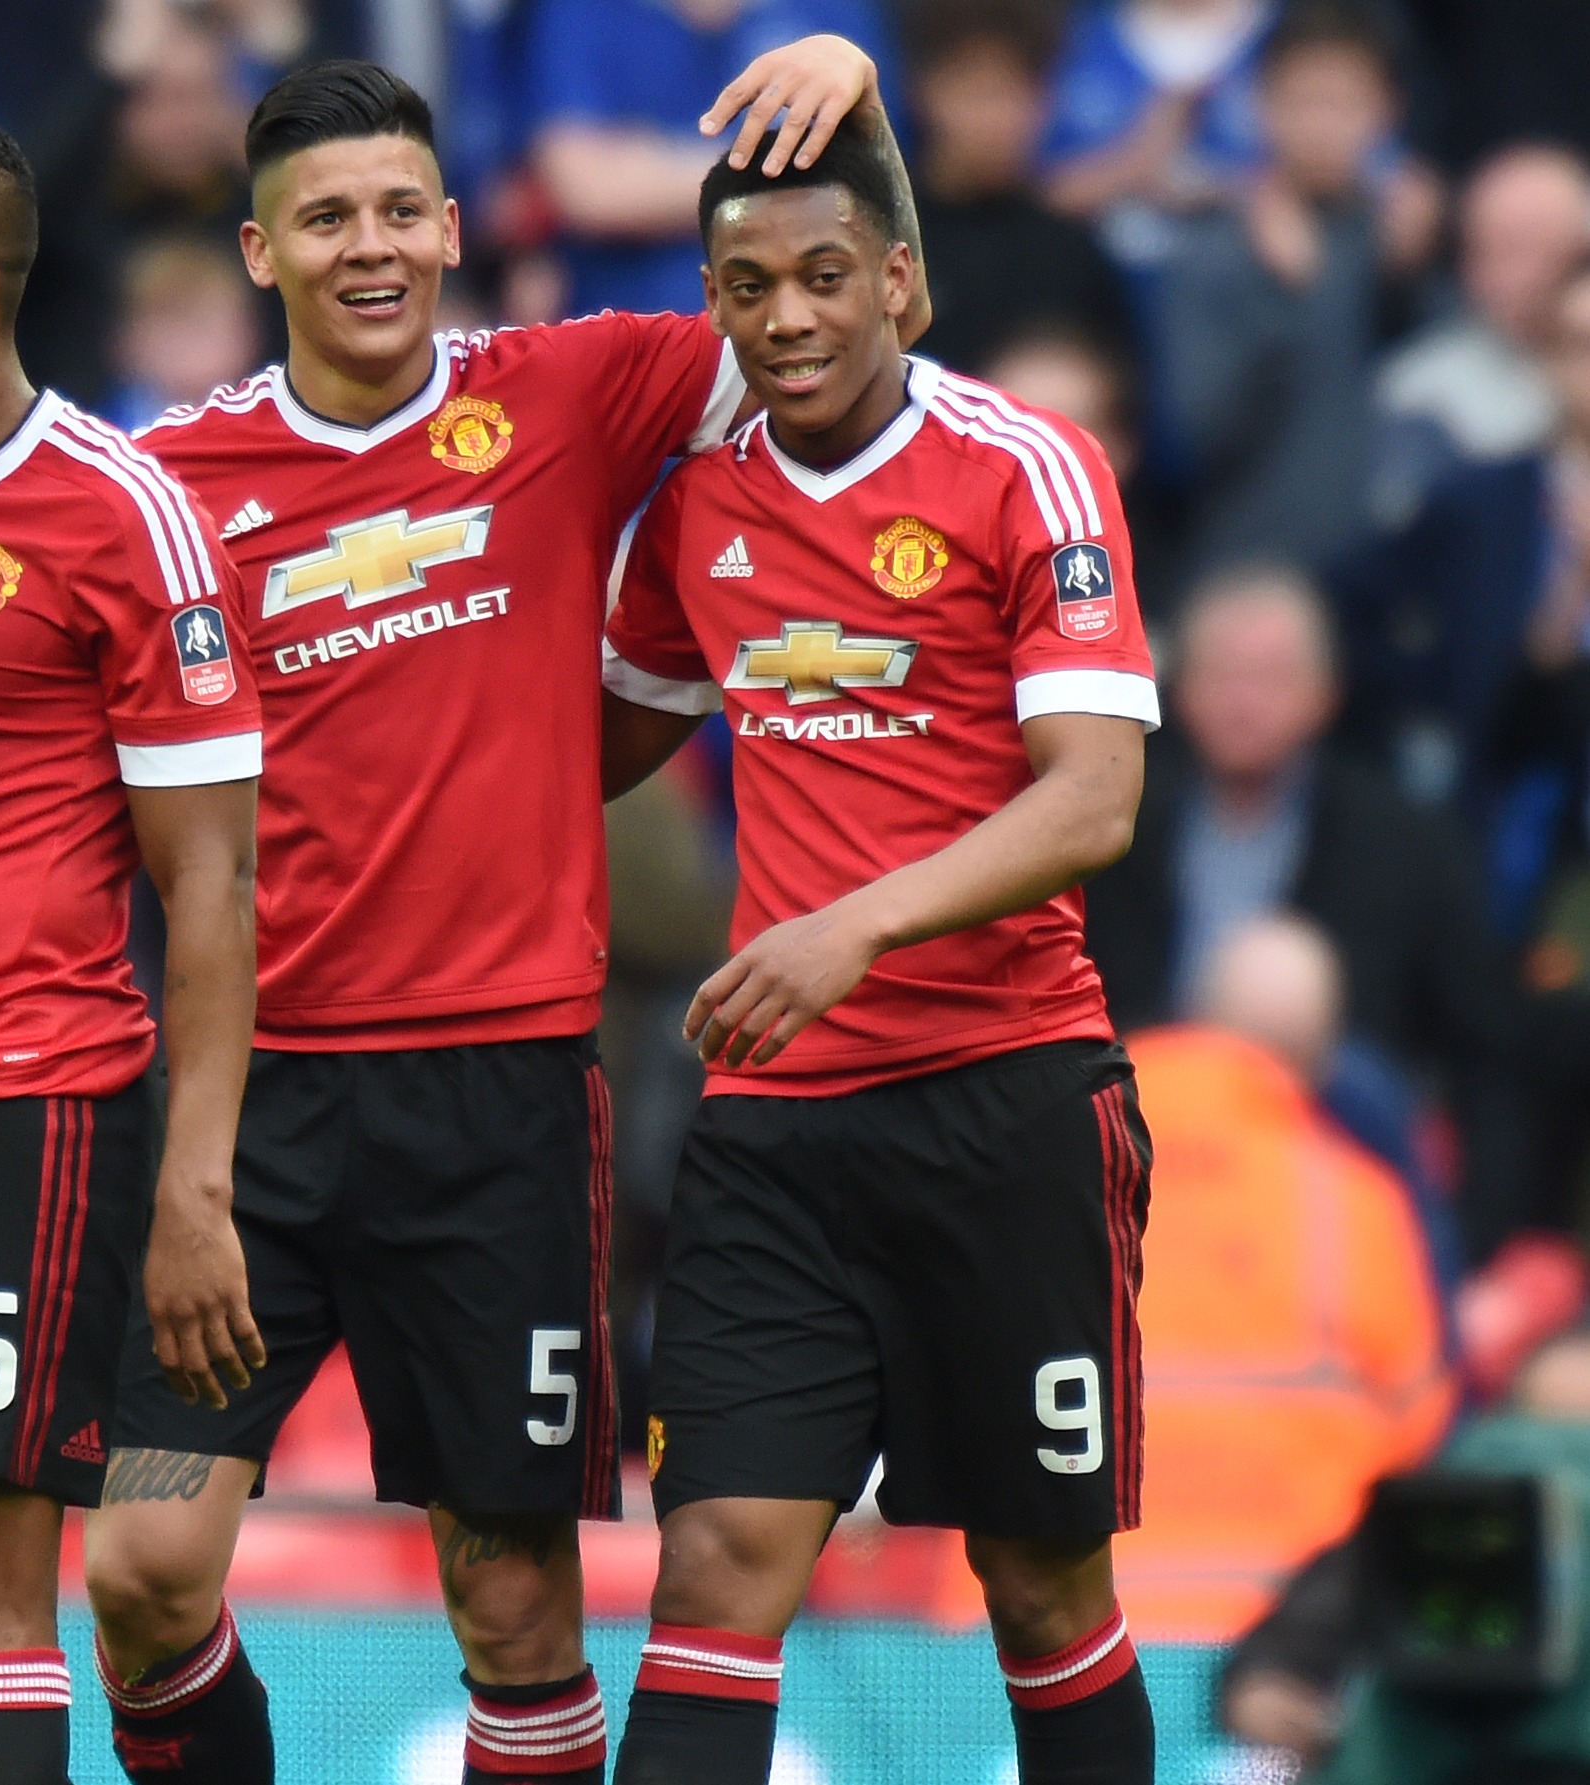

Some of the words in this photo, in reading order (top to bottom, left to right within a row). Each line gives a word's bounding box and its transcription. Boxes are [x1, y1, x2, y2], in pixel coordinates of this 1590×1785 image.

[434, 401, 499, 438] MANCHESTER
[458, 448, 503, 469] UNITED
[880, 521, 942, 551] MANCHESTER
[710, 563, 754, 578] adidas
[886, 579, 931, 594] UNITED
[275, 587, 512, 674] CHEVROLET
[527, 1330, 581, 1446] 5
[1035, 1357, 1103, 1474] 9
[60, 1443, 107, 1465] adidas
